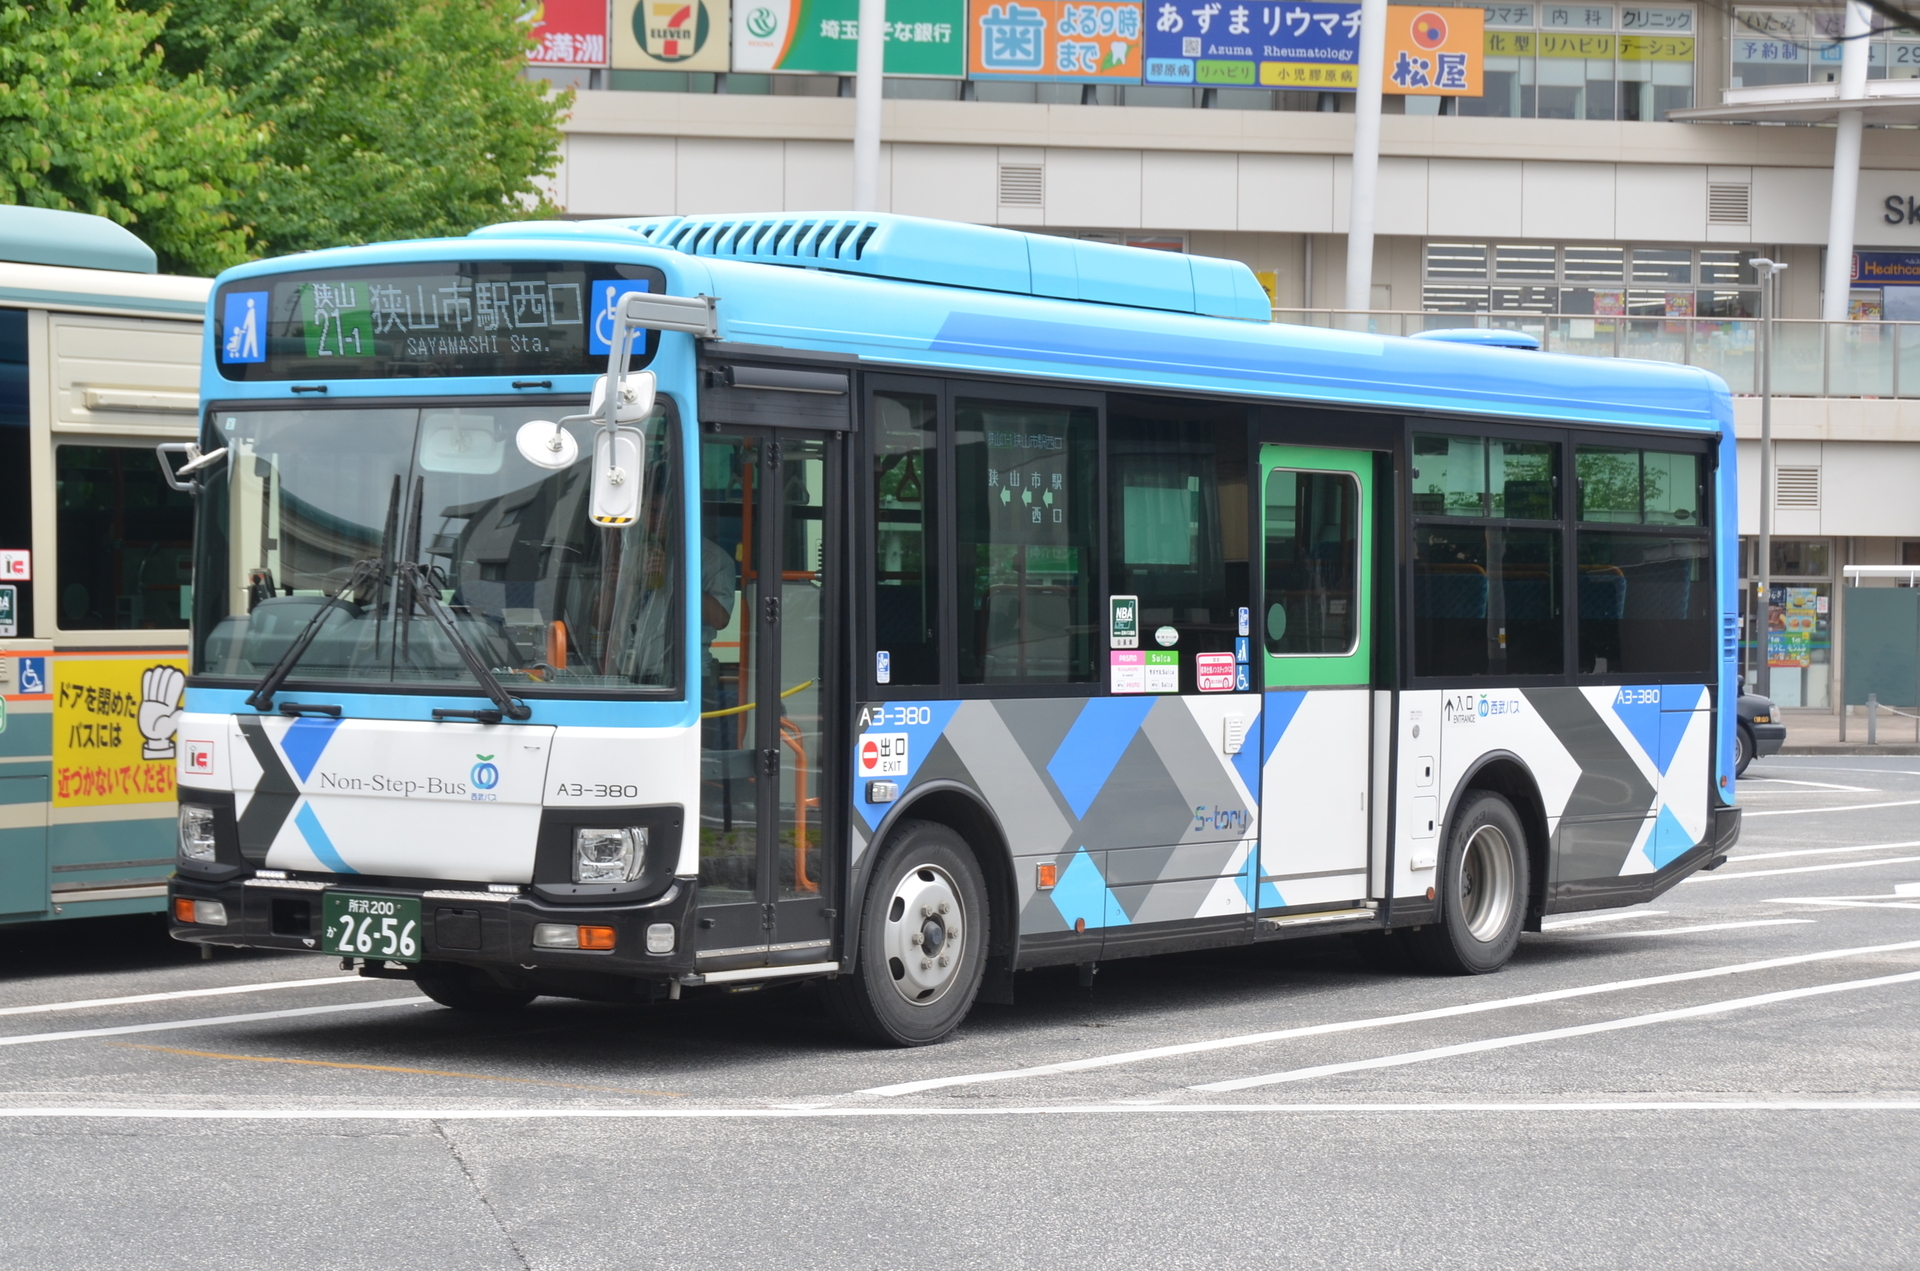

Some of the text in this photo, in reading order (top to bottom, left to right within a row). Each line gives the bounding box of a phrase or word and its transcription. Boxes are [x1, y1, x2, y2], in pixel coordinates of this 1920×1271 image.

[1058, 5, 1138, 39] よる9時
[1623, 11, 1690, 29] クリニック
[979, 4, 1046, 70] 歯
[1058, 41, 1100, 73] まで
[1208, 44, 1354, 61] Azuma Rheumatology
[1742, 41, 1798, 61] 予約制
[1151, 63, 1191, 77] 膠原病
[1201, 66, 1250, 79] リハビリ
[1278, 67, 1353, 82] 小児膠原病
[1391, 50, 1467, 90] 松屋
[312, 282, 356, 308] 狭山
[368, 281, 583, 335] 狭山市駅西口
[314, 308, 361, 356] 21-1
[407, 334, 550, 356] SAYAMASHI Sta.
[988, 468, 1063, 490] 狭山市駅
[1031, 506, 1063, 523] 西口
[1115, 607, 1133, 619] NBA
[1151, 653, 1171, 662] Suica
[58, 681, 137, 719] ドアを閉めた
[1455, 695, 1474, 712] 入口
[1616, 689, 1660, 705] A3-380
[859, 707, 931, 727] A3-380
[1490, 700, 1520, 715] 西武バス
[1453, 714, 1476, 724] ENTRANCE
[68, 722, 123, 749] バスには
[880, 737, 905, 758] 出口
[882, 760, 902, 772] EXIT
[320, 771, 467, 797] Non-Step-Bus
[556, 783, 638, 798] A3-380
[1194, 805, 1248, 835] S-tory
[326, 925, 338, 938] か
[338, 914, 416, 956] 26-56
